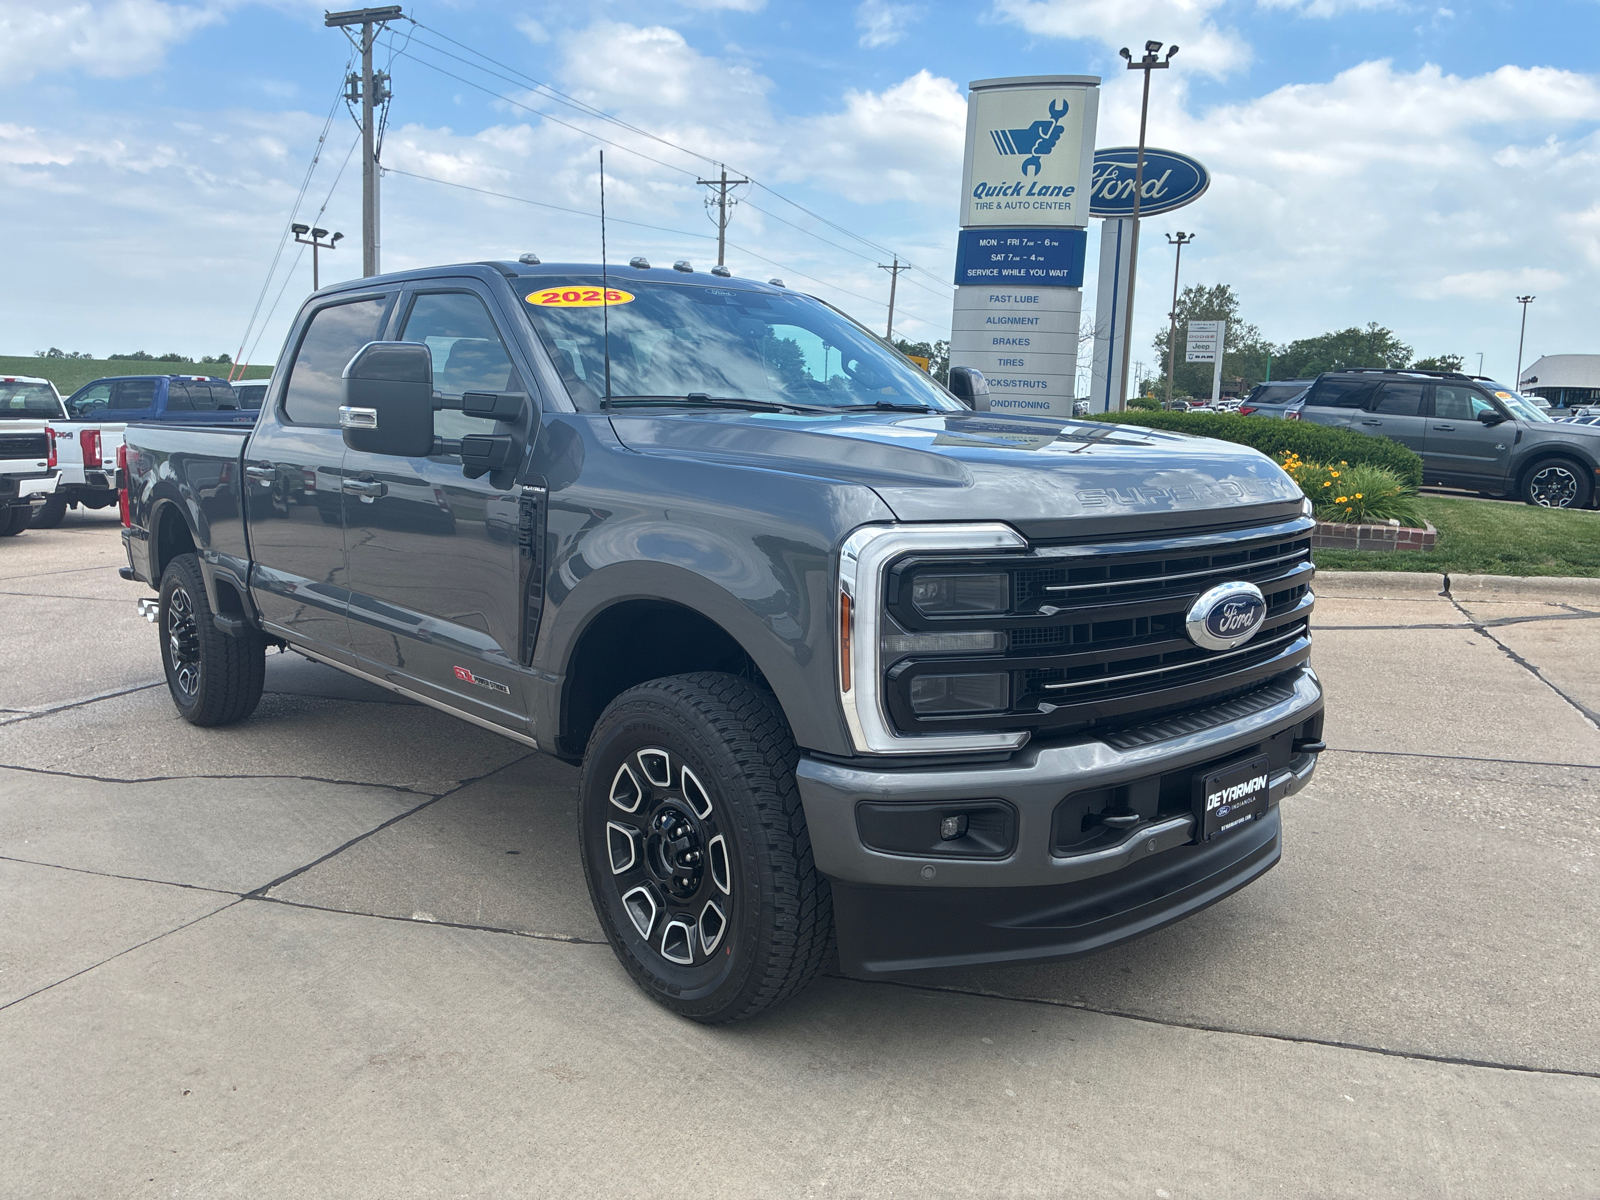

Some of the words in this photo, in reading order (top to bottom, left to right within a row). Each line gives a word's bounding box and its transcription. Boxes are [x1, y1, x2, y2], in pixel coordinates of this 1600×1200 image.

[1091, 161, 1173, 200] Ford
[973, 182, 1025, 200] Quick
[1025, 181, 1075, 198] Lane
[975, 202, 994, 211] TIRE
[996, 202, 1002, 210] &
[1004, 202, 1030, 210] AUTO
[1032, 202, 1071, 211] CENTER
[1048, 269, 1068, 277] WAIT
[541, 290, 622, 304] 2026
[989, 295, 1012, 303] FAST
[1014, 295, 1040, 304] LUBE
[986, 316, 1040, 325] ALIGNMENT
[992, 337, 1031, 346] BRAKES
[1192, 343, 1210, 351] Jeep
[998, 358, 1024, 367] TIRES
[984, 378, 1048, 389] OCKS/STRUTS
[990, 399, 1050, 410] ONDITIONING
[1075, 481, 1217, 509] SUPER
[1217, 476, 1289, 499] DUTY
[1219, 601, 1254, 632] Ford
[1206, 774, 1268, 811] DEYARMAN
[1231, 796, 1256, 811] INDIANOLA
